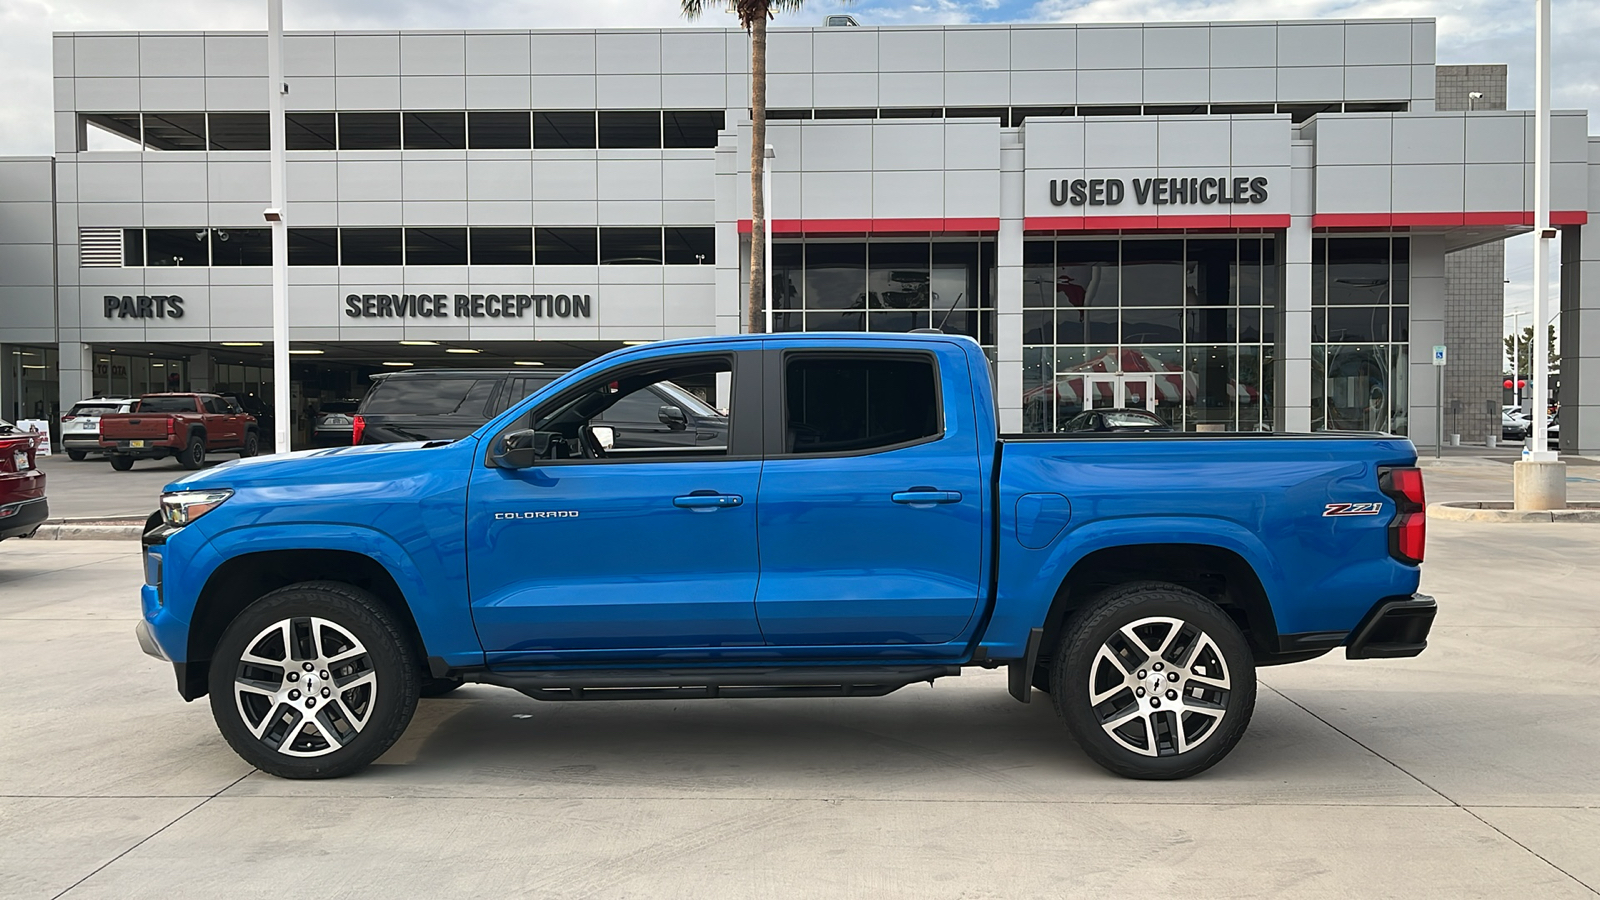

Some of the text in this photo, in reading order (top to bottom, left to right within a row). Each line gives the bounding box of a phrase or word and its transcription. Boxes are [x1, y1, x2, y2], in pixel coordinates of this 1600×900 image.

[1049, 177, 1268, 206] USED VEHICLES
[103, 295, 184, 318] PARTS
[345, 294, 590, 318] SERVICE RECEPTION
[97, 364, 127, 376] TOOTA
[494, 510, 579, 520] COLORADO
[1322, 503, 1383, 517] Z71
